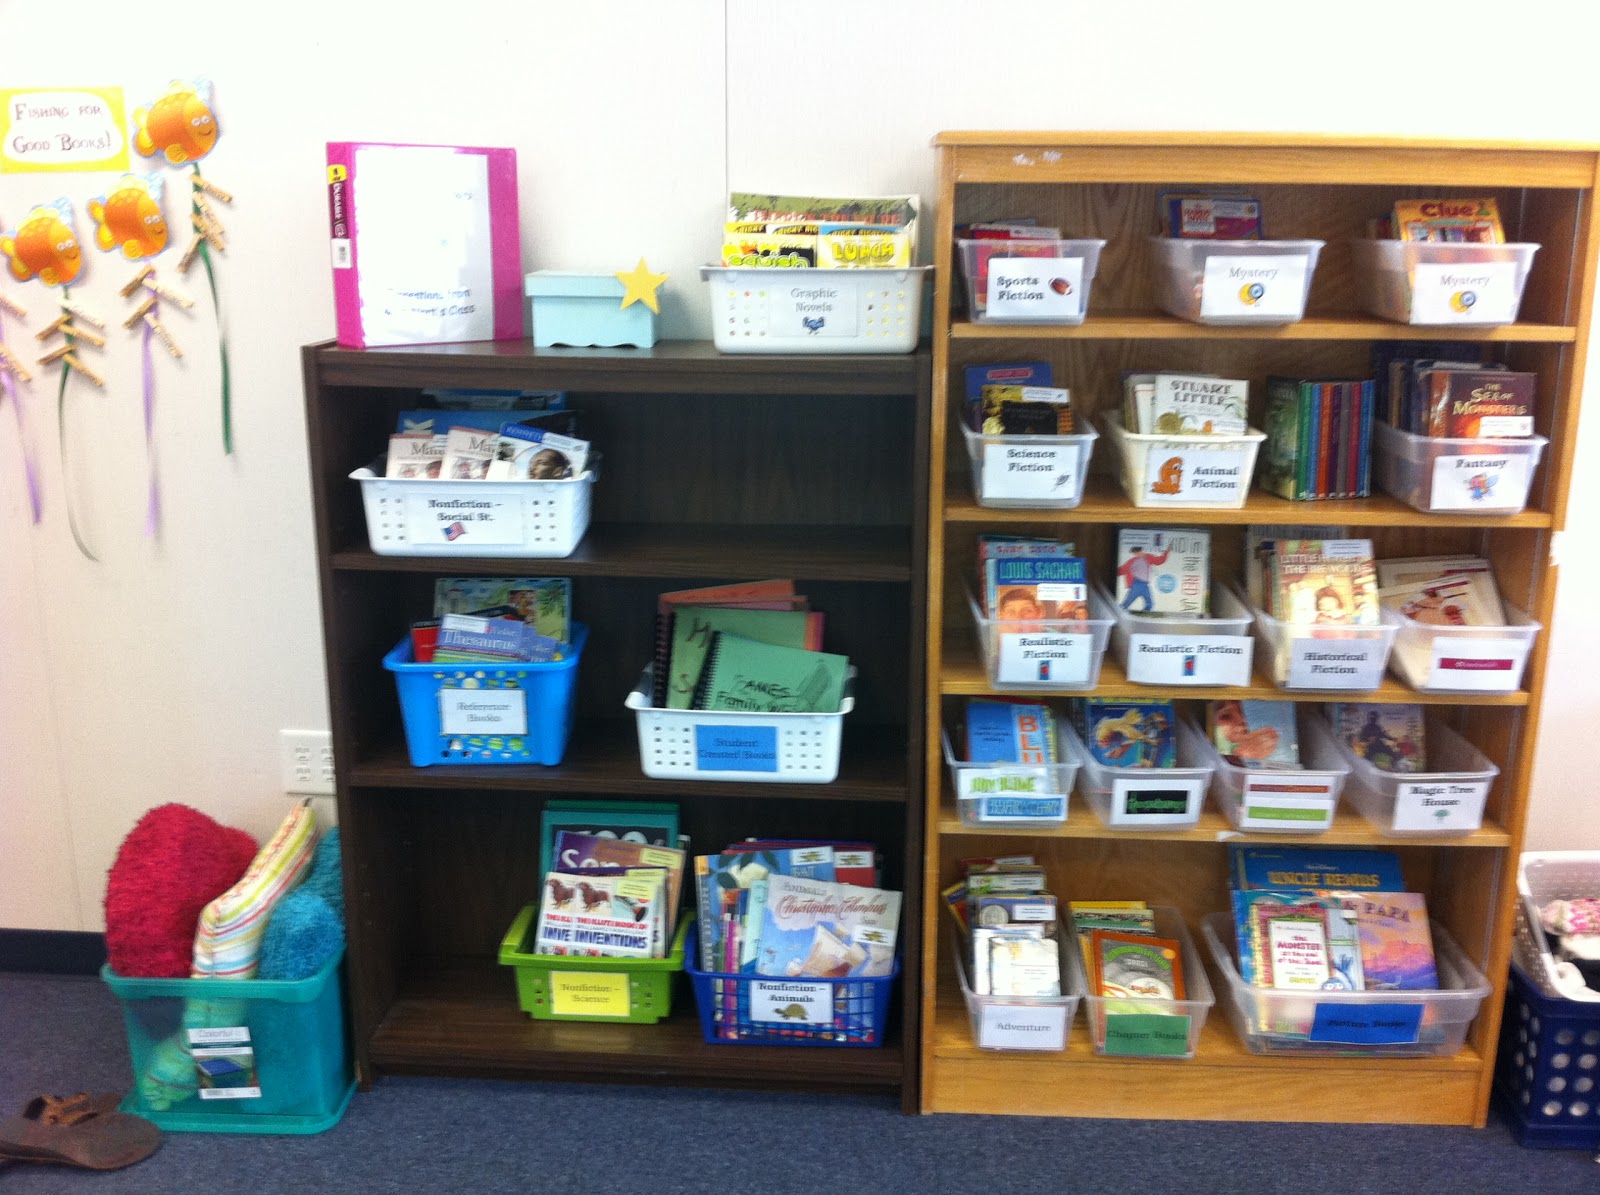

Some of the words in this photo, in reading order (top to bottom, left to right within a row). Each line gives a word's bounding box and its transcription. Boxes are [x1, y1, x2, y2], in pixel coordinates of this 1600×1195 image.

[1420, 201, 1473, 218] Clue
[831, 242, 895, 261] LUNCH
[1228, 267, 1280, 280] Mystery
[996, 276, 1040, 289] Sports
[1439, 274, 1491, 288] Mystery
[790, 288, 838, 301] Graphic
[997, 290, 1045, 301] Fiction
[795, 302, 833, 312] Novels
[1007, 449, 1057, 459] Science
[1008, 462, 1055, 472] Fiction
[1455, 459, 1509, 470] Fantasy
[1192, 466, 1240, 476] Animal
[1190, 479, 1238, 489] Fiction
[428, 499, 493, 509] Nonfiction
[437, 512, 473, 522] Social
[477, 512, 495, 522] St.
[1000, 561, 1033, 580] LOUIS
[1034, 561, 1083, 580] SACHAR
[442, 629, 518, 650] Thesaurus
[1018, 638, 1074, 647] Realistic
[1138, 643, 1193, 654] Realistic
[1196, 644, 1244, 655] Fiction
[1023, 650, 1069, 659] Fiction
[1303, 652, 1368, 662] Historical
[1310, 665, 1359, 674] Fiction
[467, 714, 503, 723] Books
[713, 738, 760, 748] Student
[1410, 786, 1446, 796] Magic
[1449, 786, 1476, 794] Tree
[1421, 798, 1461, 807] House
[560, 983, 612, 993] Nonfiction
[758, 982, 817, 992] Nonfiction
[769, 994, 815, 1003] Animals
[996, 1022, 1051, 1032] Adventure
